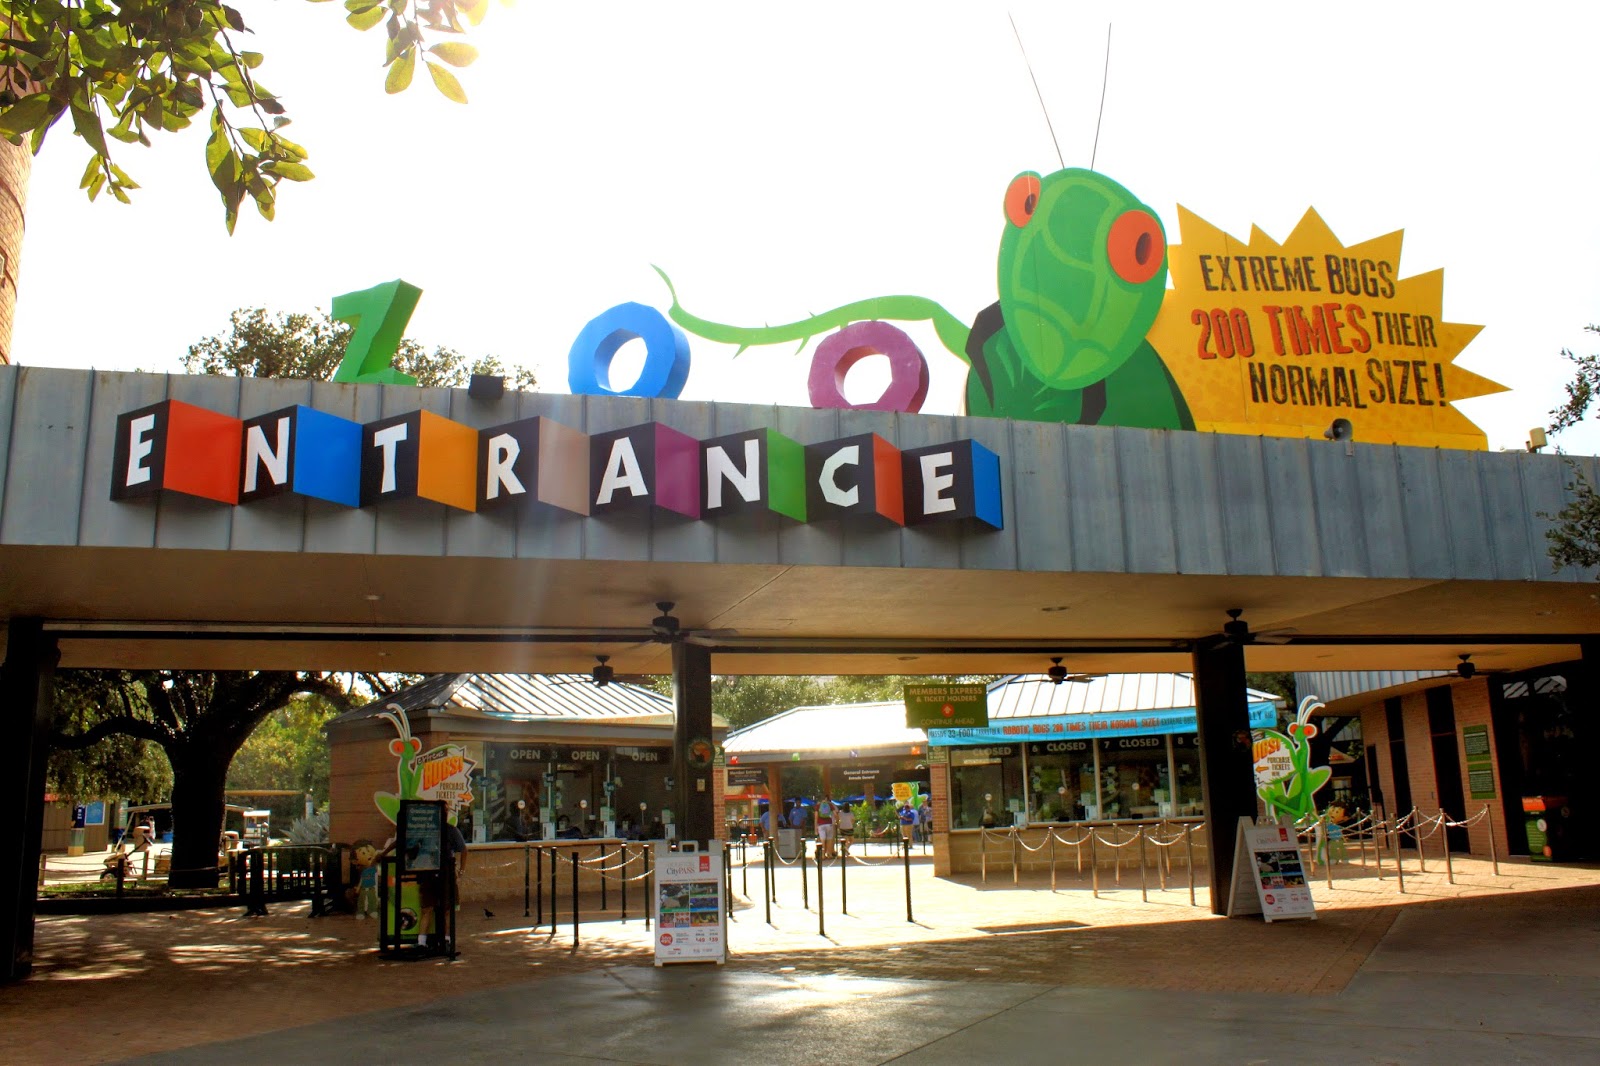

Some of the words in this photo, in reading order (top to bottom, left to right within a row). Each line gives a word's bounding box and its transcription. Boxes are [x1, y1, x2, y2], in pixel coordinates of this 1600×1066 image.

[1199, 254, 1321, 292] EXTREME
[1324, 254, 1396, 299] BUGS
[1191, 307, 1255, 360] 200
[1262, 303, 1372, 356] TIMES
[1372, 311, 1438, 348] THEIR
[1248, 362, 1368, 409] NORMAL
[1365, 358, 1447, 407] SIZE!
[126, 413, 957, 515] ENTRANCE
[909, 688, 947, 696] MEMBERS
[949, 687, 982, 695] EXPRESS
[920, 718, 952, 726] CONTINUE
[929, 730, 947, 738] MASSIVE
[947, 729, 974, 739] 33-FOOT
[1002, 724, 1030, 735] ROBOTIC
[1032, 723, 1050, 733] BUGS
[1066, 721, 1086, 732] TIMES
[1089, 720, 1108, 731] THEIR
[1110, 718, 1138, 729] NORMAL
[1104, 741, 1110, 749] 7
[1119, 738, 1160, 748] CLOSED
[1178, 737, 1184, 745] 8
[972, 747, 1012, 756] CLOSED
[1046, 742, 1087, 752] CLOSED
[489, 750, 496, 759] 2
[510, 749, 541, 760] OPEN
[571, 751, 600, 761] OPEN
[632, 752, 658, 762] OPEN
[423, 756, 465, 791] BUGS!
[440, 782, 465, 790] PURCHASE
[435, 791, 456, 799] TICKETS
